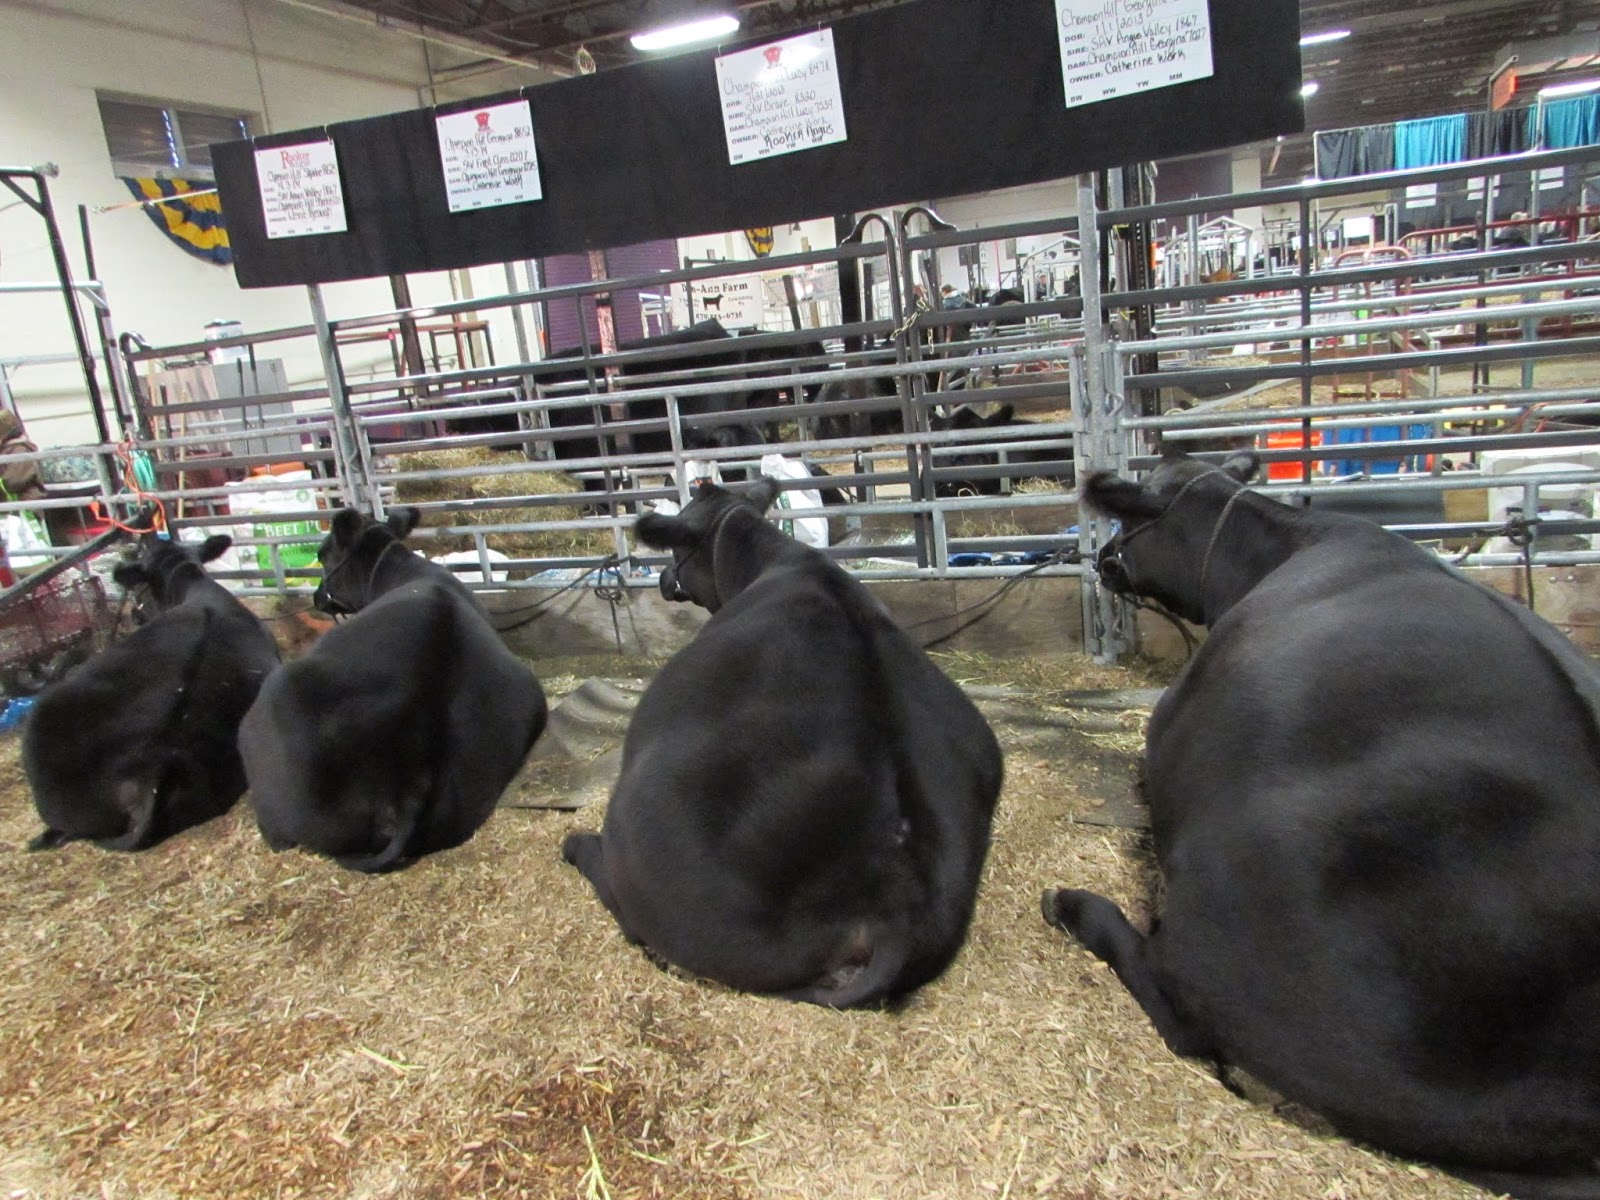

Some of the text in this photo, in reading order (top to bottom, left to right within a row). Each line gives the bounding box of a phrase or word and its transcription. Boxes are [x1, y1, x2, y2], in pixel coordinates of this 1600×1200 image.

[1064, 33, 1086, 43] DOB:
[1066, 47, 1089, 56] SIRE:
[1142, 21, 1171, 38] Valley
[1067, 61, 1088, 71] DAM:
[1069, 49, 1186, 84] OWNER: Catherine Work
[1102, 87, 1117, 96] WW
[1136, 80, 1150, 89] YW
[1168, 72, 1183, 82] MM
[731, 134, 759, 145] OWNER:
[722, 282, 748, 293] Farm
